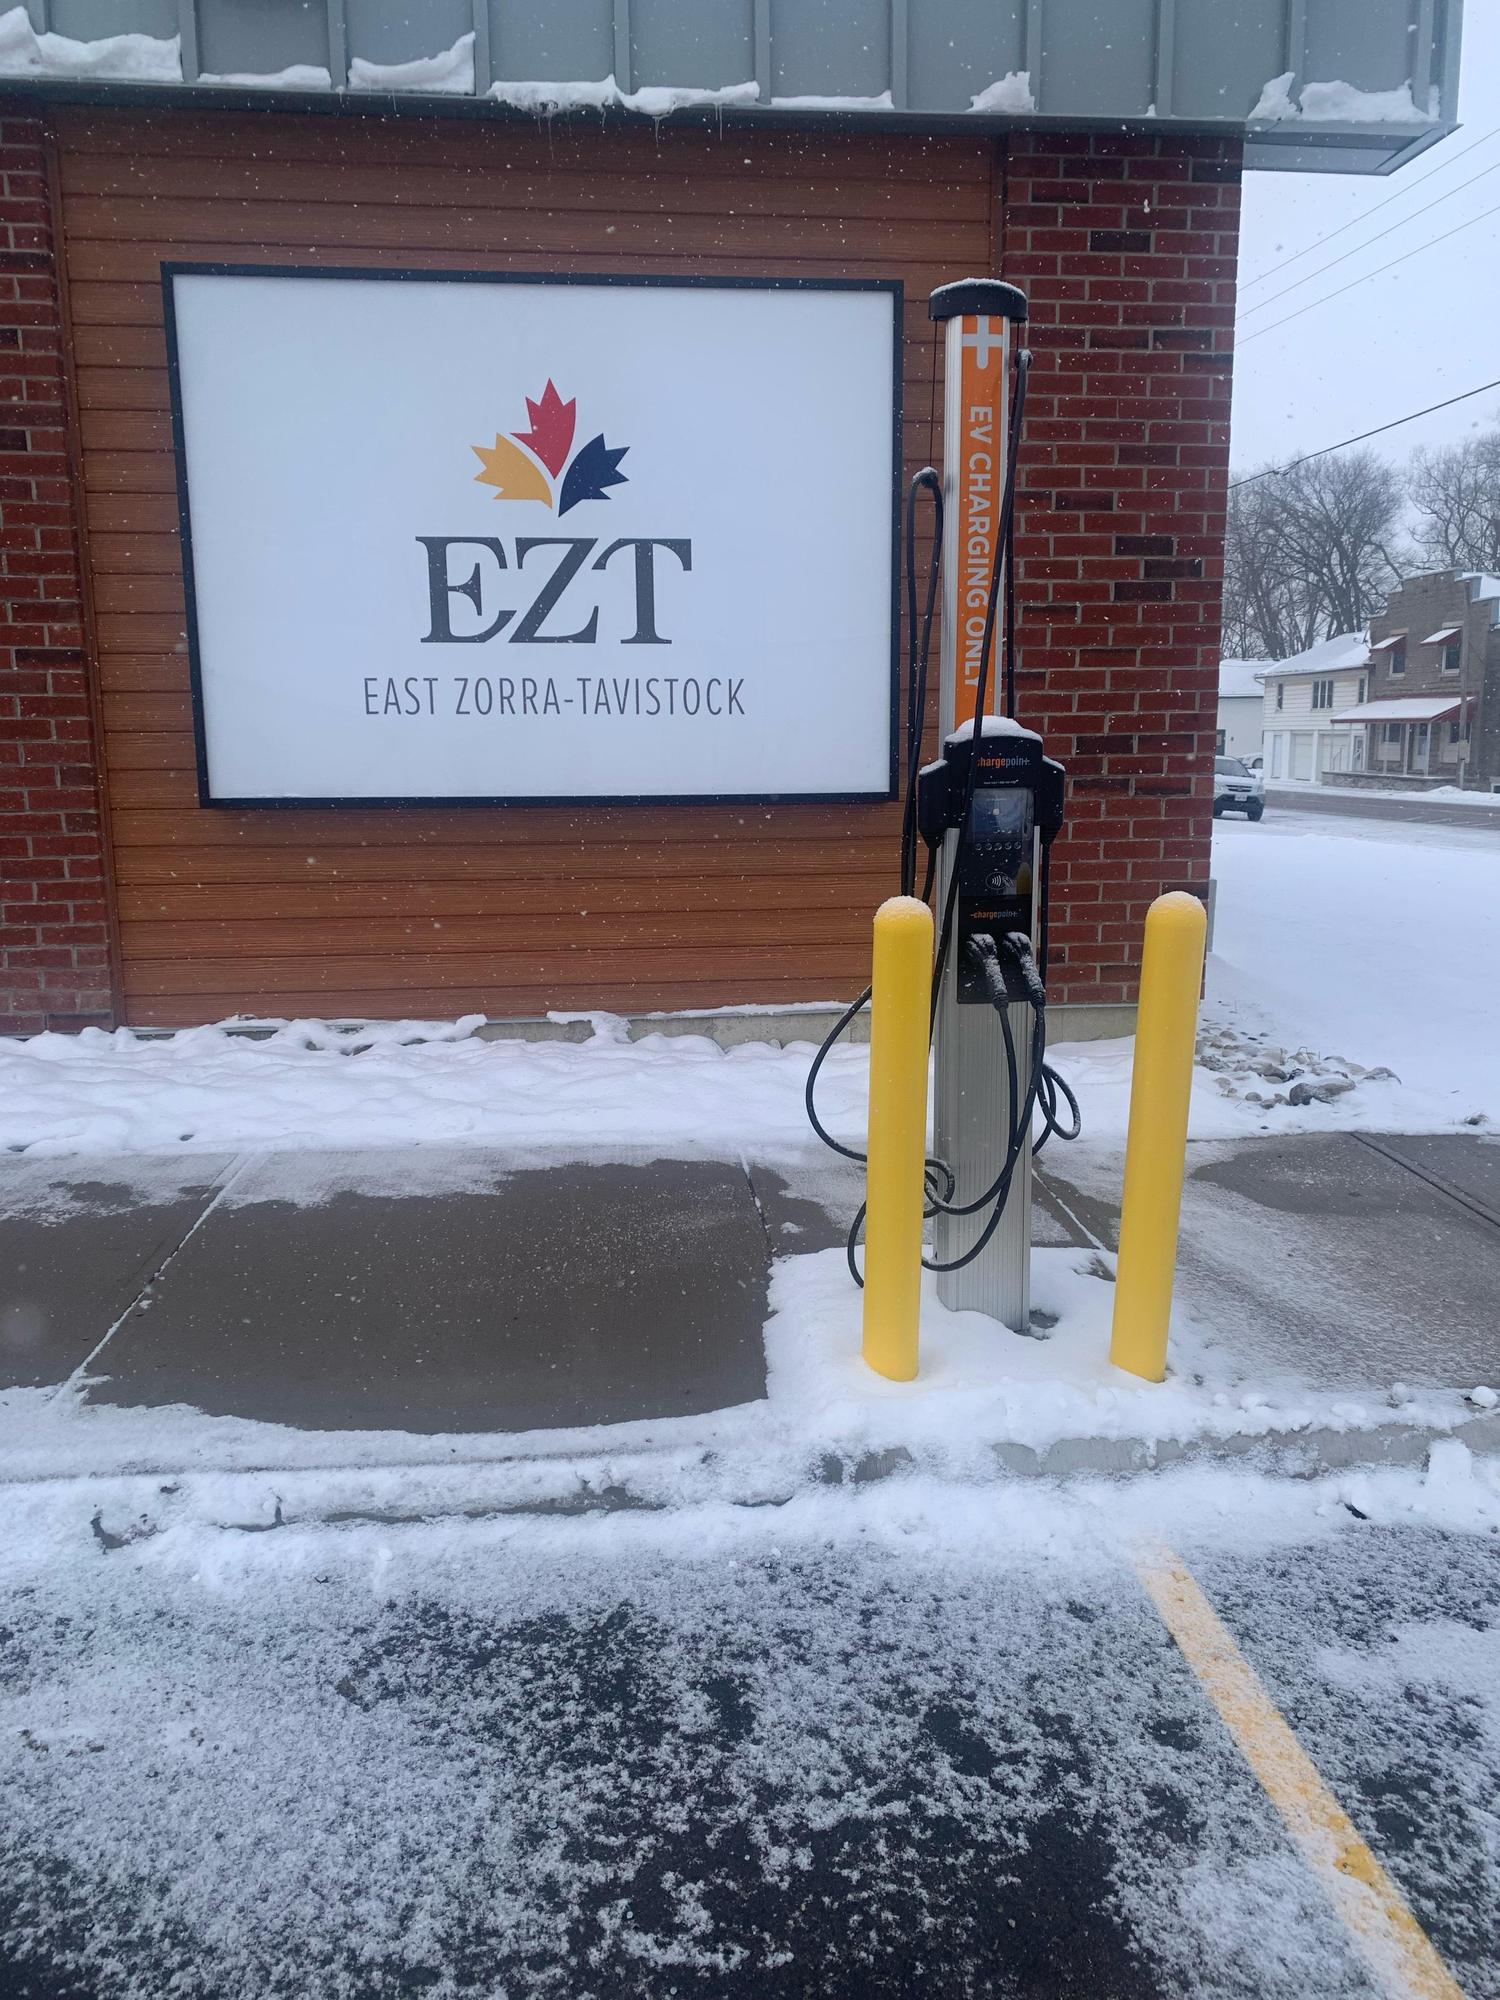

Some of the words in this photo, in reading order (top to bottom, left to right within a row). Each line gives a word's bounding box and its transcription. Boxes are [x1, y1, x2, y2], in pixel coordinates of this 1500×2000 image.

[968, 406, 992, 444] EV
[967, 452, 992, 608] CHARGING
[415, 535, 692, 644] EZT
[363, 676, 439, 716] EAST
[454, 676, 746, 716] ZORRA-TAVISTOCK
